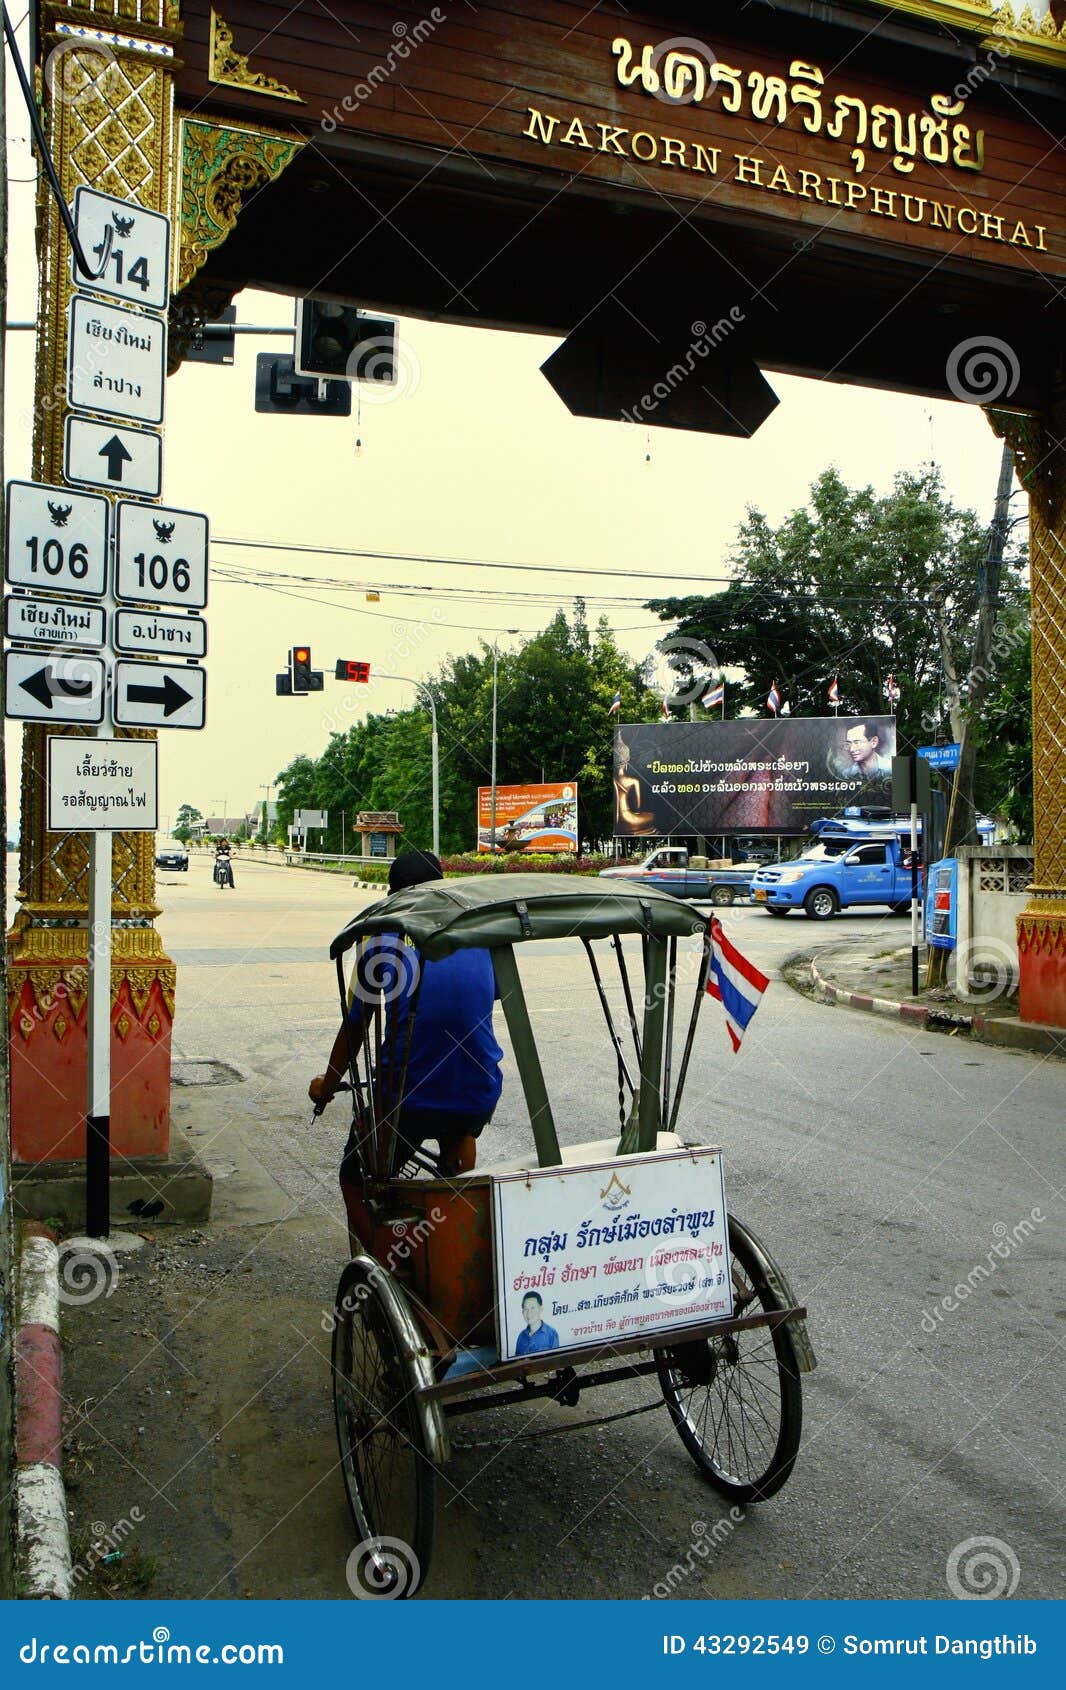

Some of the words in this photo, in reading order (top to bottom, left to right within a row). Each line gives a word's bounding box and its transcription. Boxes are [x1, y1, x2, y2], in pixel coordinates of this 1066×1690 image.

[612, 37, 985, 174] นครหริภุญชัย
[521, 107, 721, 175] NAKORN
[733, 153, 1048, 252] HARIPHUNCHAI
[85, 318, 152, 352] เชียงใหม่
[93, 371, 142, 398] ลำปาง
[25, 536, 89, 580] 106
[133, 552, 191, 593] 106
[20, 604, 92, 630] เชียงใหม่
[33, 626, 79, 641] (สายเก่า)
[76, 753, 134, 778] เลี้ยวซ้าย
[61, 787, 147, 812] รอสัญญาณไฟ
[523, 1230, 568, 1263] กลุ่ม
[576, 1208, 715, 1248] รักษ์เมืองลำพูน
[603, 1255, 643, 1276] พัฒนา
